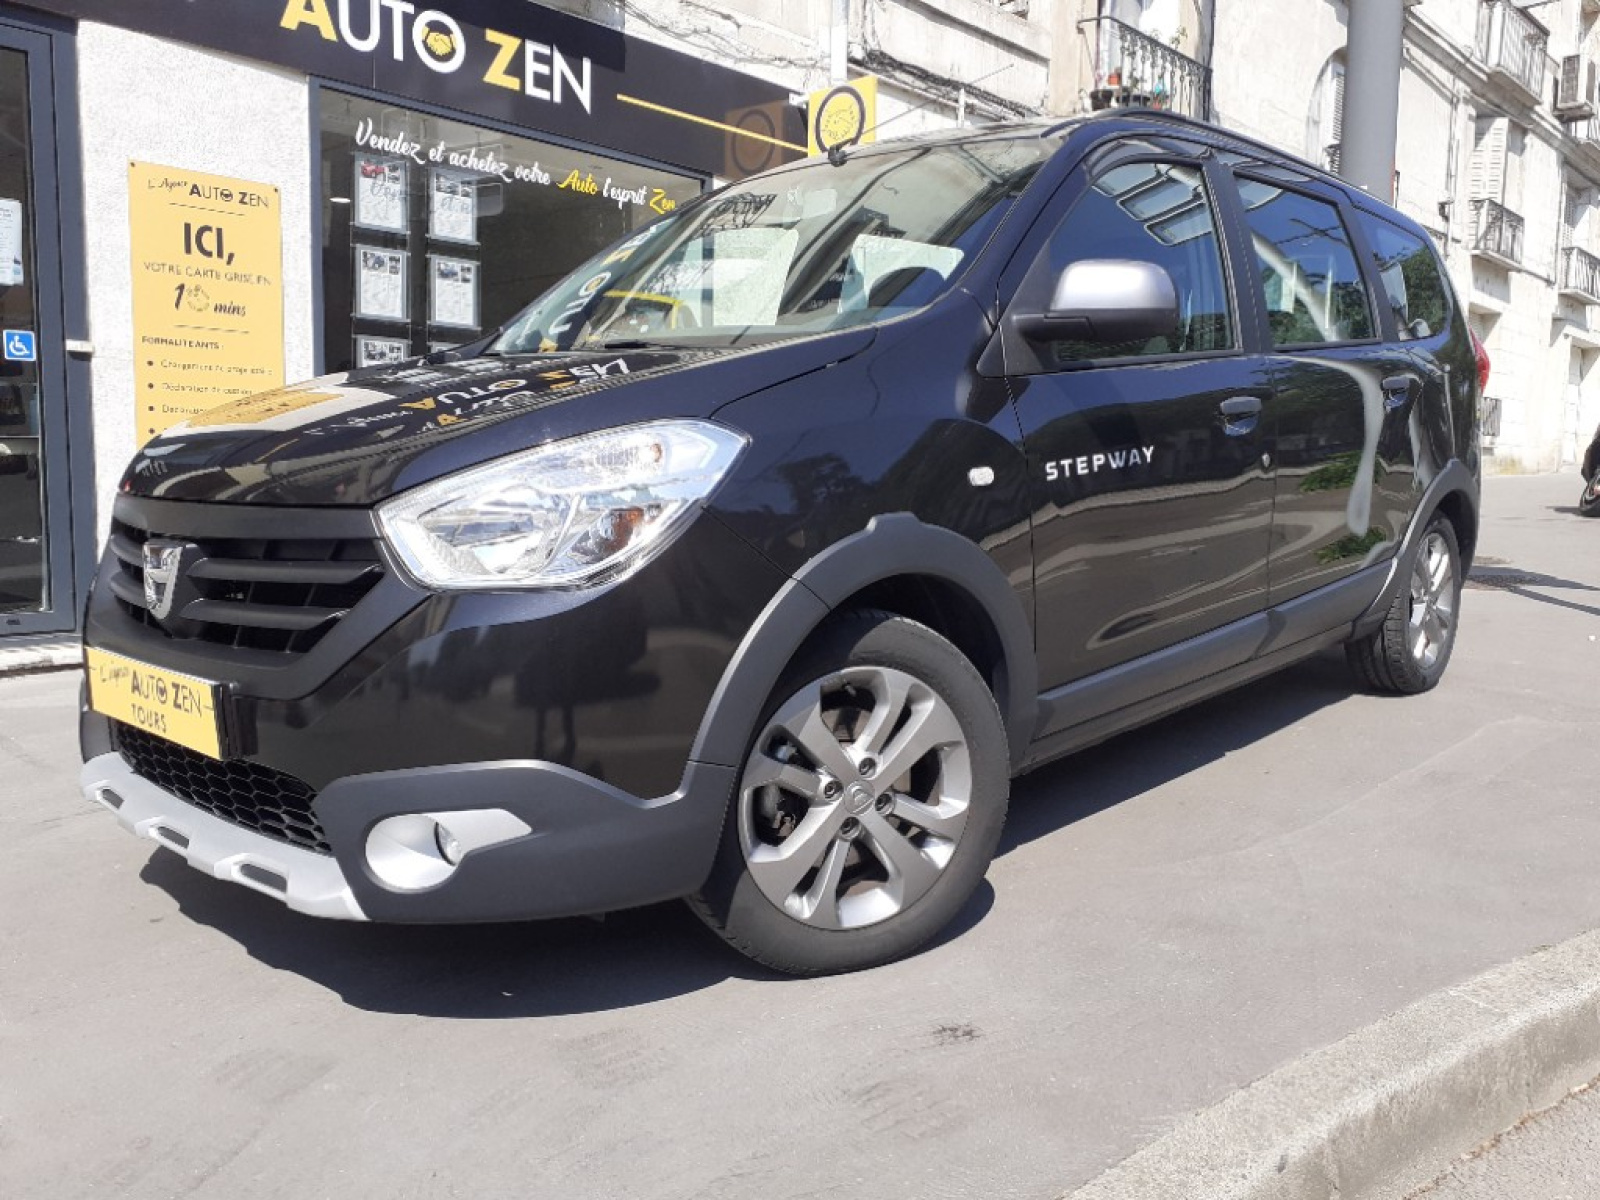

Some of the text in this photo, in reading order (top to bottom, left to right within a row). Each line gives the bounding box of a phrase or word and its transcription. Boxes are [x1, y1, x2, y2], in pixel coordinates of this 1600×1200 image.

[280, 0, 591, 115] AUTO ZEN
[355, 117, 425, 164] Vendez
[429, 140, 445, 162] et
[450, 147, 512, 183] achetez
[513, 161, 551, 185] votre
[556, 169, 598, 195] Auto
[649, 188, 676, 215] Zen
[189, 183, 234, 202] AUTO
[238, 190, 269, 208] ZEN
[183, 222, 235, 266] ICI,
[143, 262, 182, 276] VOTRE
[185, 266, 221, 281] CARTE
[213, 301, 246, 317] mins
[1045, 445, 1154, 481] STEPWAY
[131, 669, 167, 704] AUTO
[171, 681, 202, 717] ZEN
[131, 703, 167, 733] TOURS
